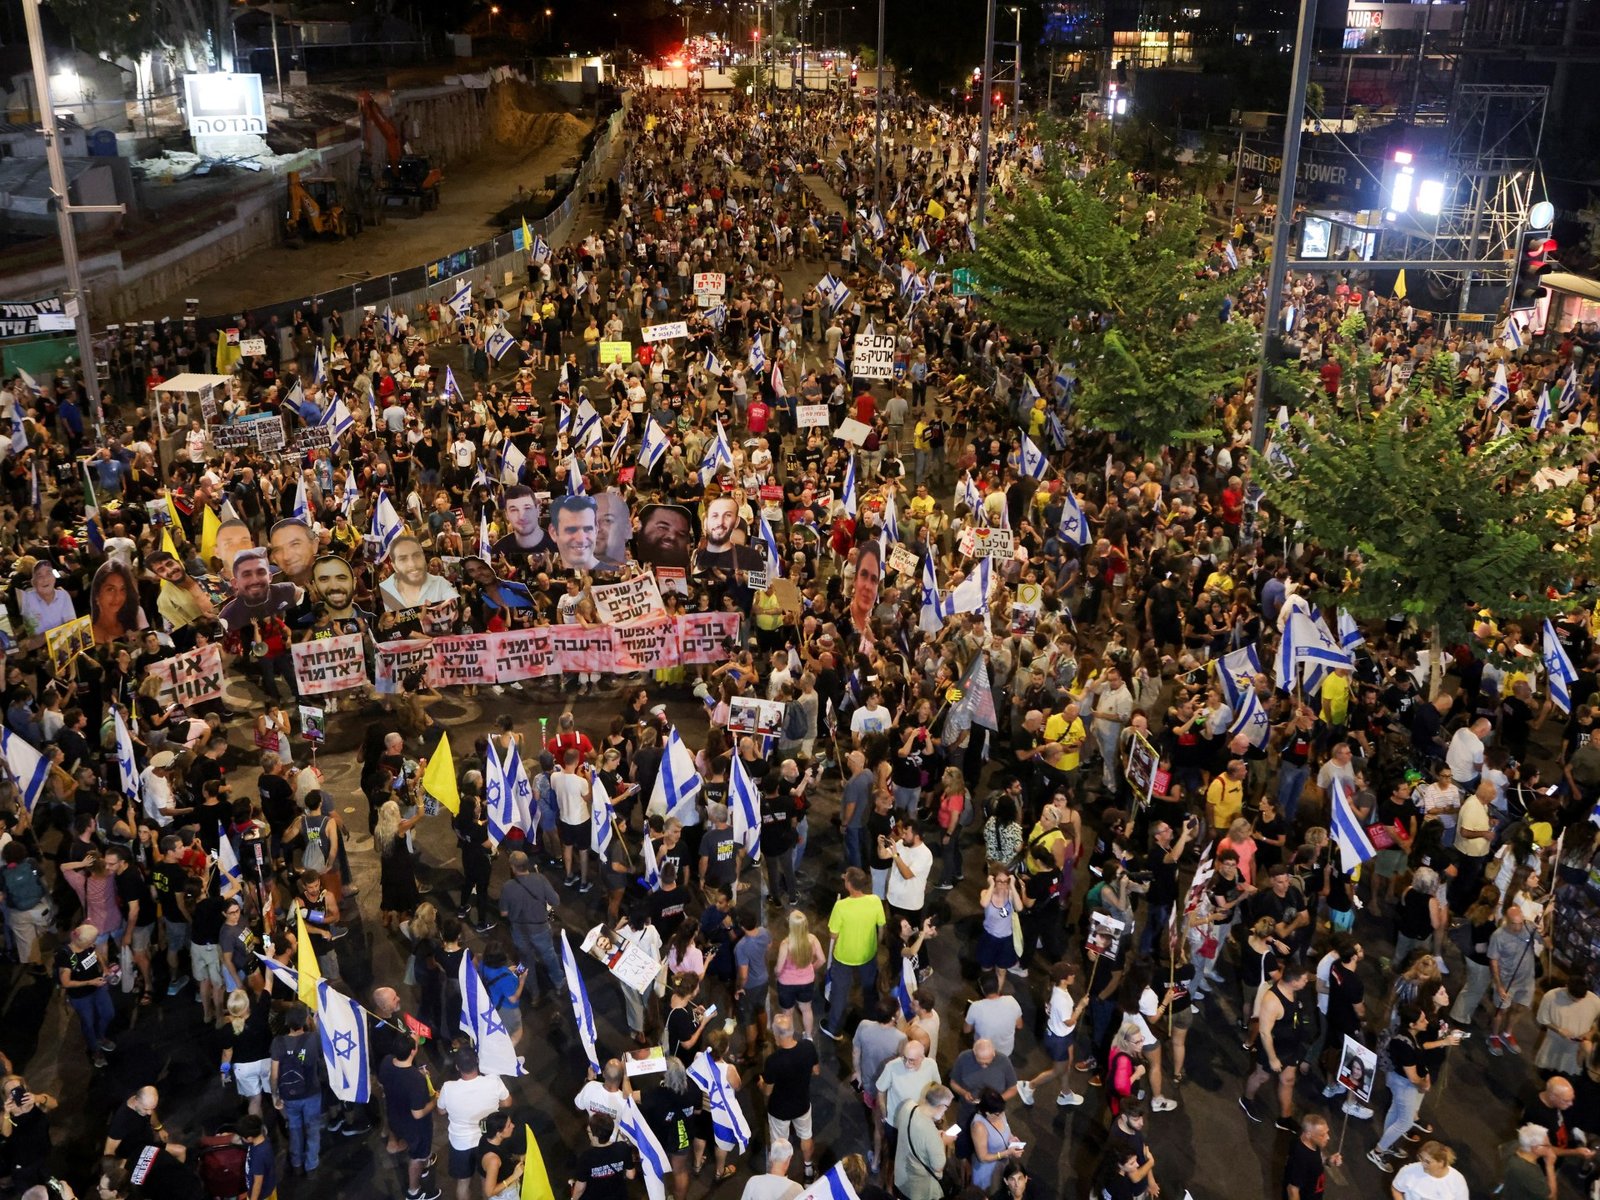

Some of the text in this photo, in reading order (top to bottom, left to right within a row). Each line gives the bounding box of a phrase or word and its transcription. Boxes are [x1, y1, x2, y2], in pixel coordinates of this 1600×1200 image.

[197, 118, 263, 133] הנדסה
[1304, 163, 1346, 184] TOWER
[981, 539, 1009, 549] שלנו
[595, 576, 656, 602] רק שניים
[608, 592, 649, 611] יכולים
[612, 603, 653, 624] לשכב
[614, 627, 673, 641] אי אפשר
[502, 636, 548, 655] סימני
[554, 639, 613, 653] הרעבה
[622, 637, 666, 652] לעמוד
[302, 646, 356, 668] מתחת
[443, 653, 479, 667] שלא
[496, 651, 555, 672] קשירה
[630, 651, 661, 666] זקוף
[169, 655, 203, 685] אין
[300, 660, 362, 683] לאדמה
[440, 667, 483, 680] טופלו
[160, 673, 221, 704] אוויר
[617, 947, 638, 977] STOP
